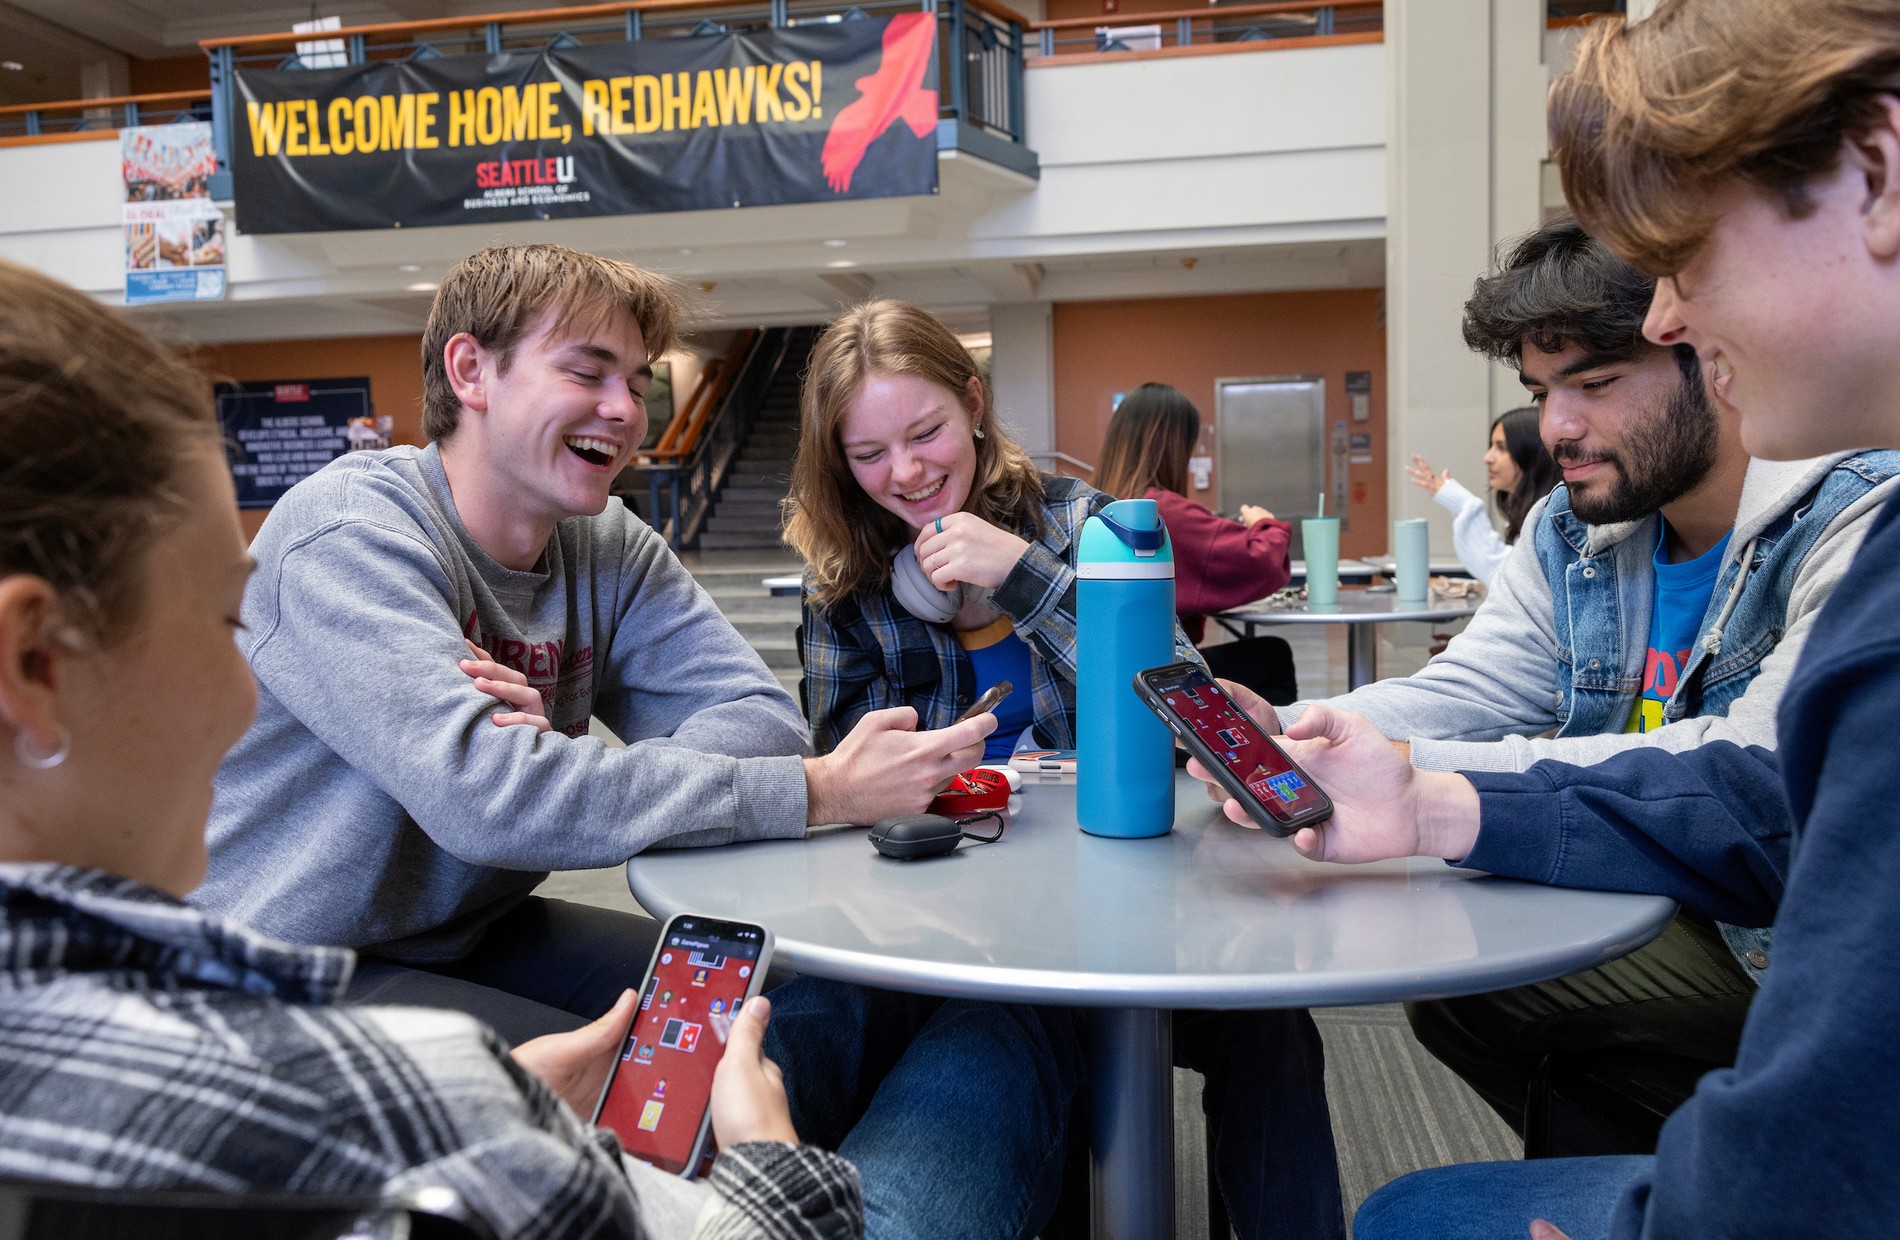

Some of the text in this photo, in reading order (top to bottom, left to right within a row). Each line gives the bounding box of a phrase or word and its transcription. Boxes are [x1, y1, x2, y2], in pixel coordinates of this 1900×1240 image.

[247, 60, 822, 157] WELCOME HOME, REDHAWKS!
[463, 191, 590, 209] BUSINESS AND ECONOMICS
[483, 183, 569, 199] ALBERS SCHOOL OF
